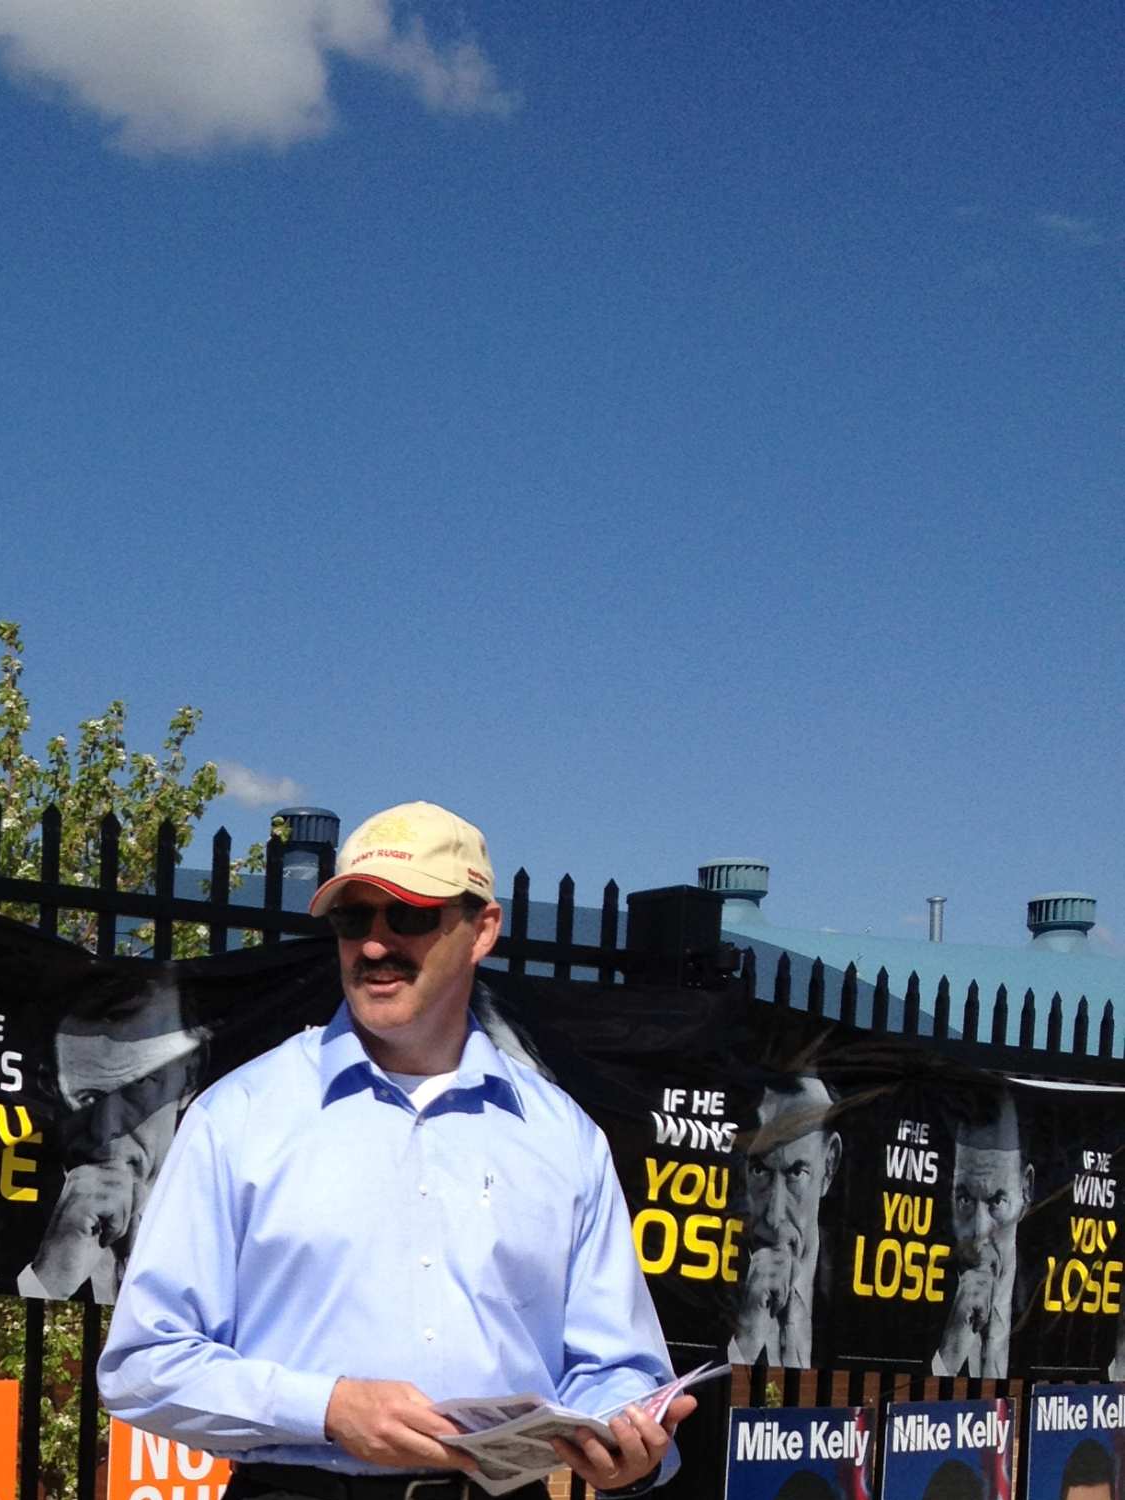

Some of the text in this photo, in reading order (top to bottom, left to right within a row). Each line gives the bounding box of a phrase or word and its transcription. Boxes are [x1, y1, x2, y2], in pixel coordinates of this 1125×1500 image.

[377, 848, 414, 861] RUGBY
[662, 1088, 725, 1115] IF HE
[651, 1110, 739, 1154] WINS
[897, 1118, 911, 1141] IF
[1083, 1150, 1095, 1170] IF
[645, 1157, 729, 1209] YOU
[1073, 1173, 1117, 1209] WINS
[883, 1191, 933, 1236] YOU
[1070, 1216, 1117, 1254] YOU
[632, 1208, 744, 1282] OSE
[852, 1234, 951, 1302] LOSE
[1044, 1256, 1124, 1314] LOSE
[892, 1411, 1010, 1455] Mike Kelly
[1037, 1394, 1125, 1431] Mike Kel
[130, 1426, 215, 1481] NO
[736, 1420, 871, 1467] Mike Kelly
